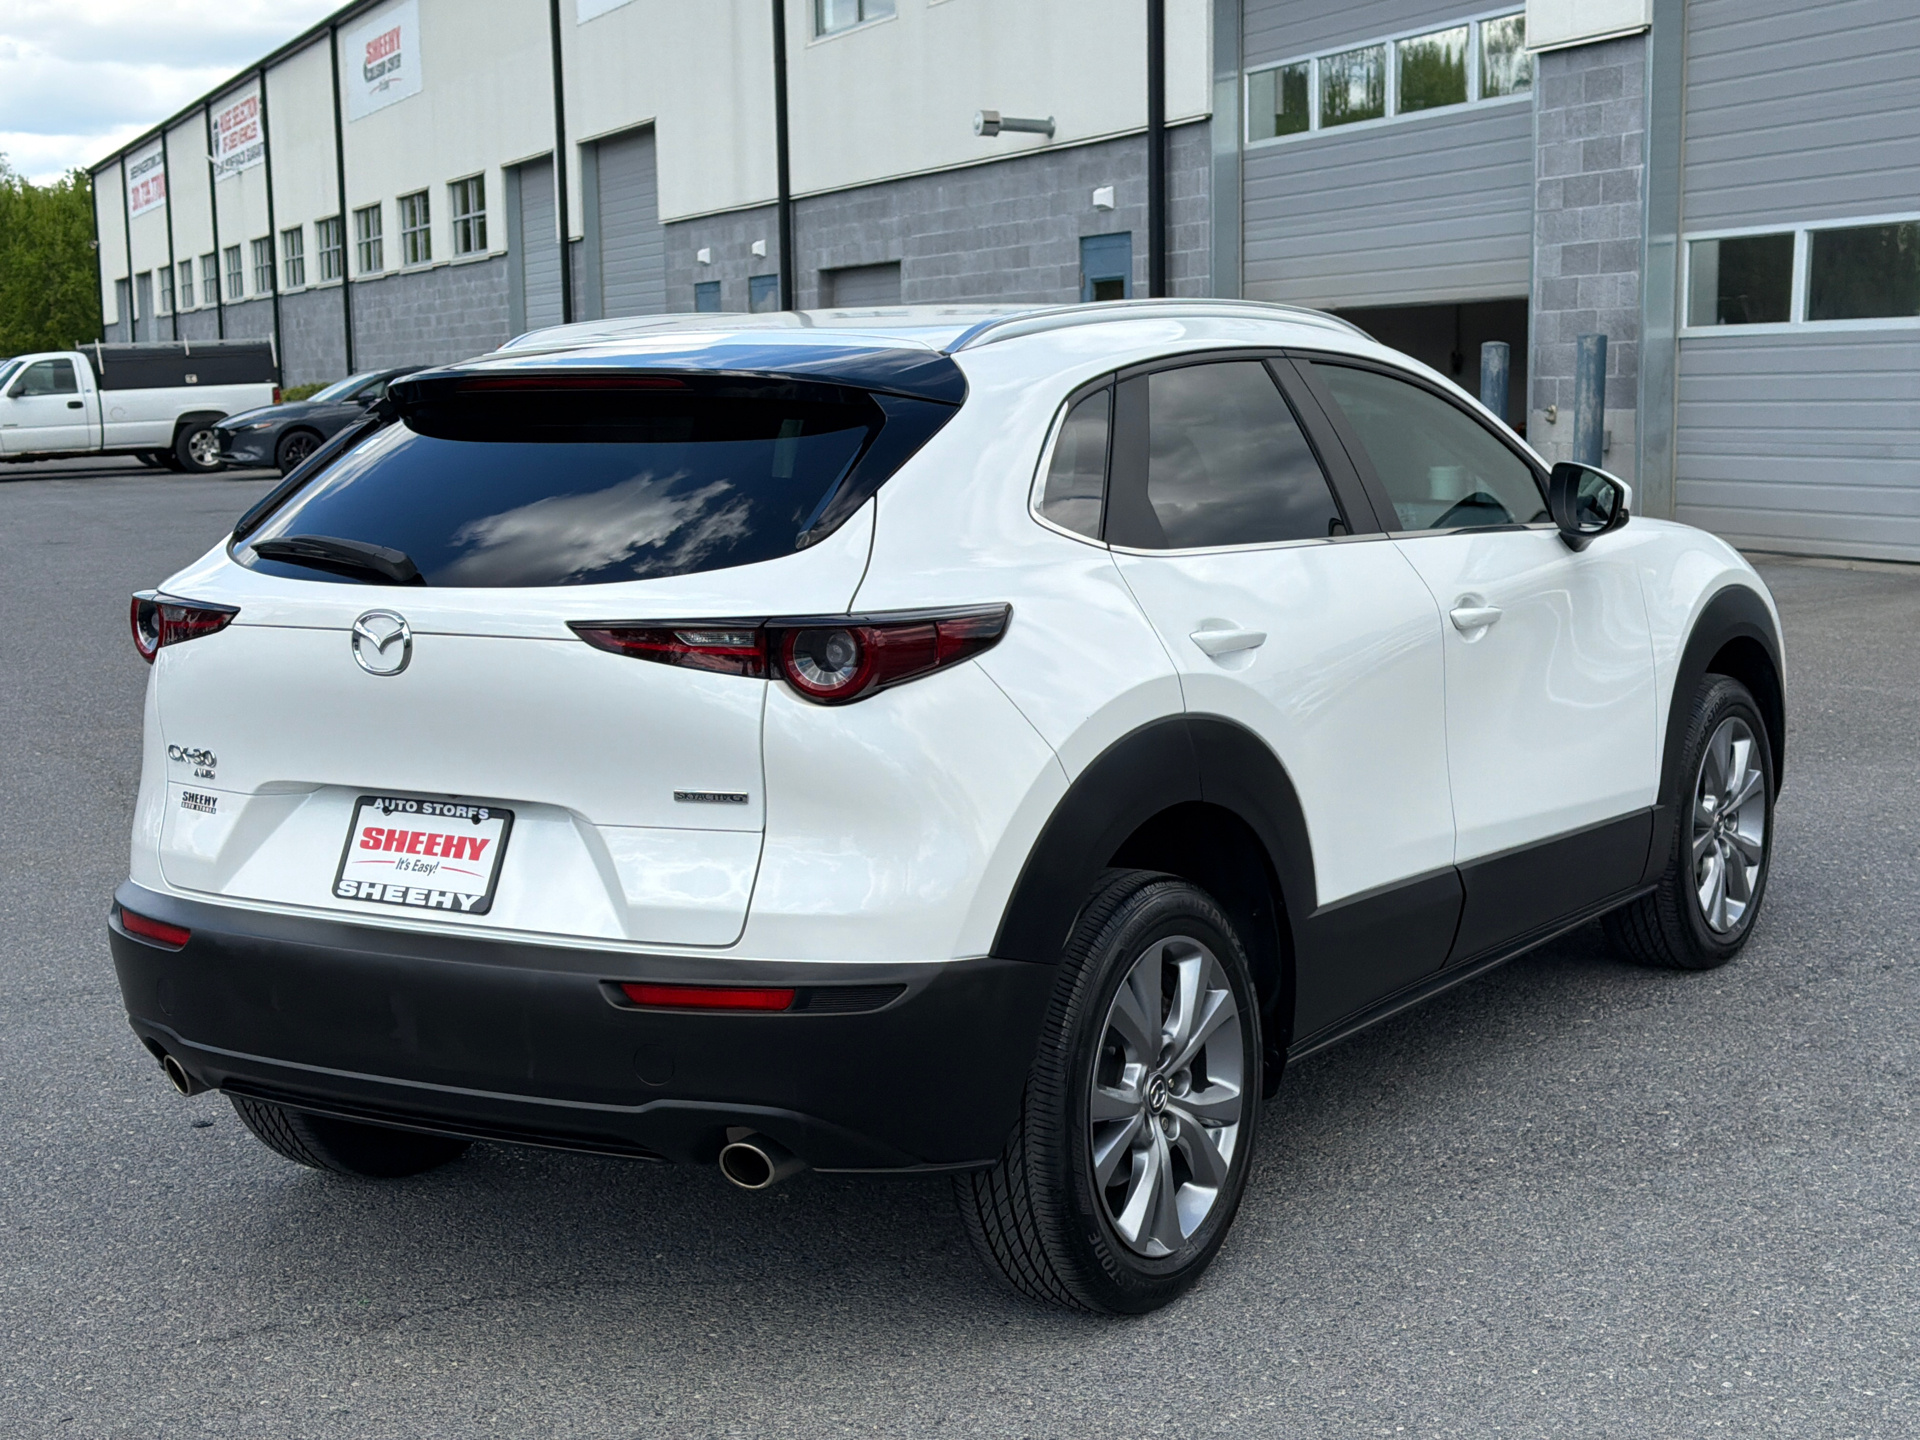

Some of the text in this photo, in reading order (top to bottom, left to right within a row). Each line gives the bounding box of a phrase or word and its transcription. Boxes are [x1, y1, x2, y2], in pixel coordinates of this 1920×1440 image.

[181, 791, 218, 808] SHEEHY
[373, 798, 418, 813] AUTO
[359, 826, 492, 862] SHEEHY
[395, 857, 441, 877] It's Easy!
[336, 879, 483, 912] SHEEHY
